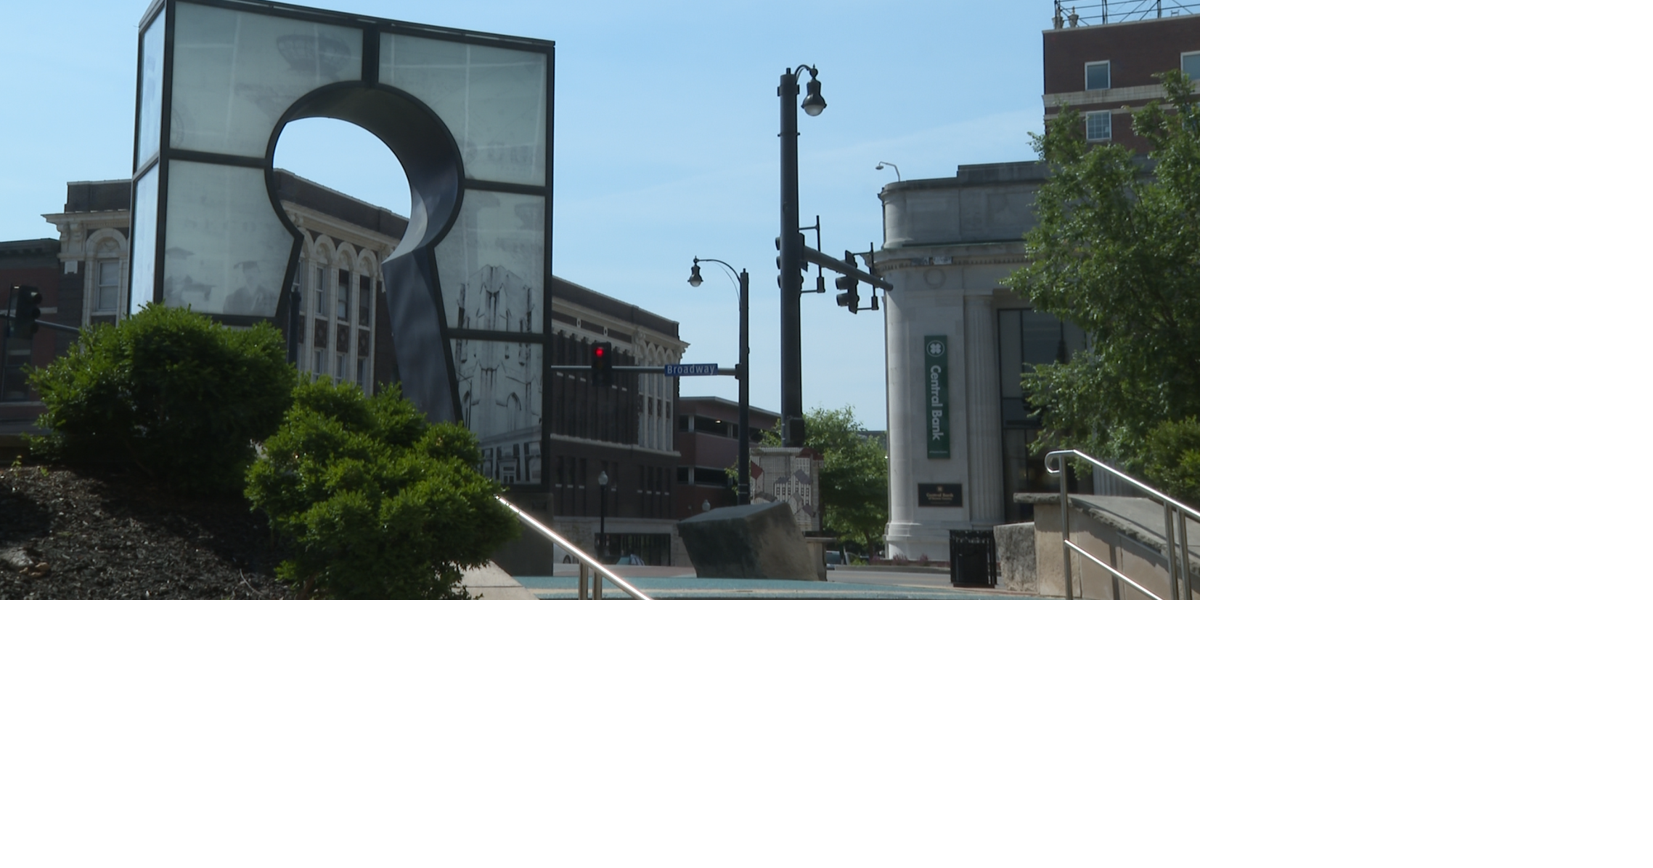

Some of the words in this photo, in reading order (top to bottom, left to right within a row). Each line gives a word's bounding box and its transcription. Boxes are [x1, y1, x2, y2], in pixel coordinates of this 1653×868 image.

[667, 364, 715, 375] Broadway
[930, 365, 943, 407] Central
[931, 410, 944, 440] Bank
